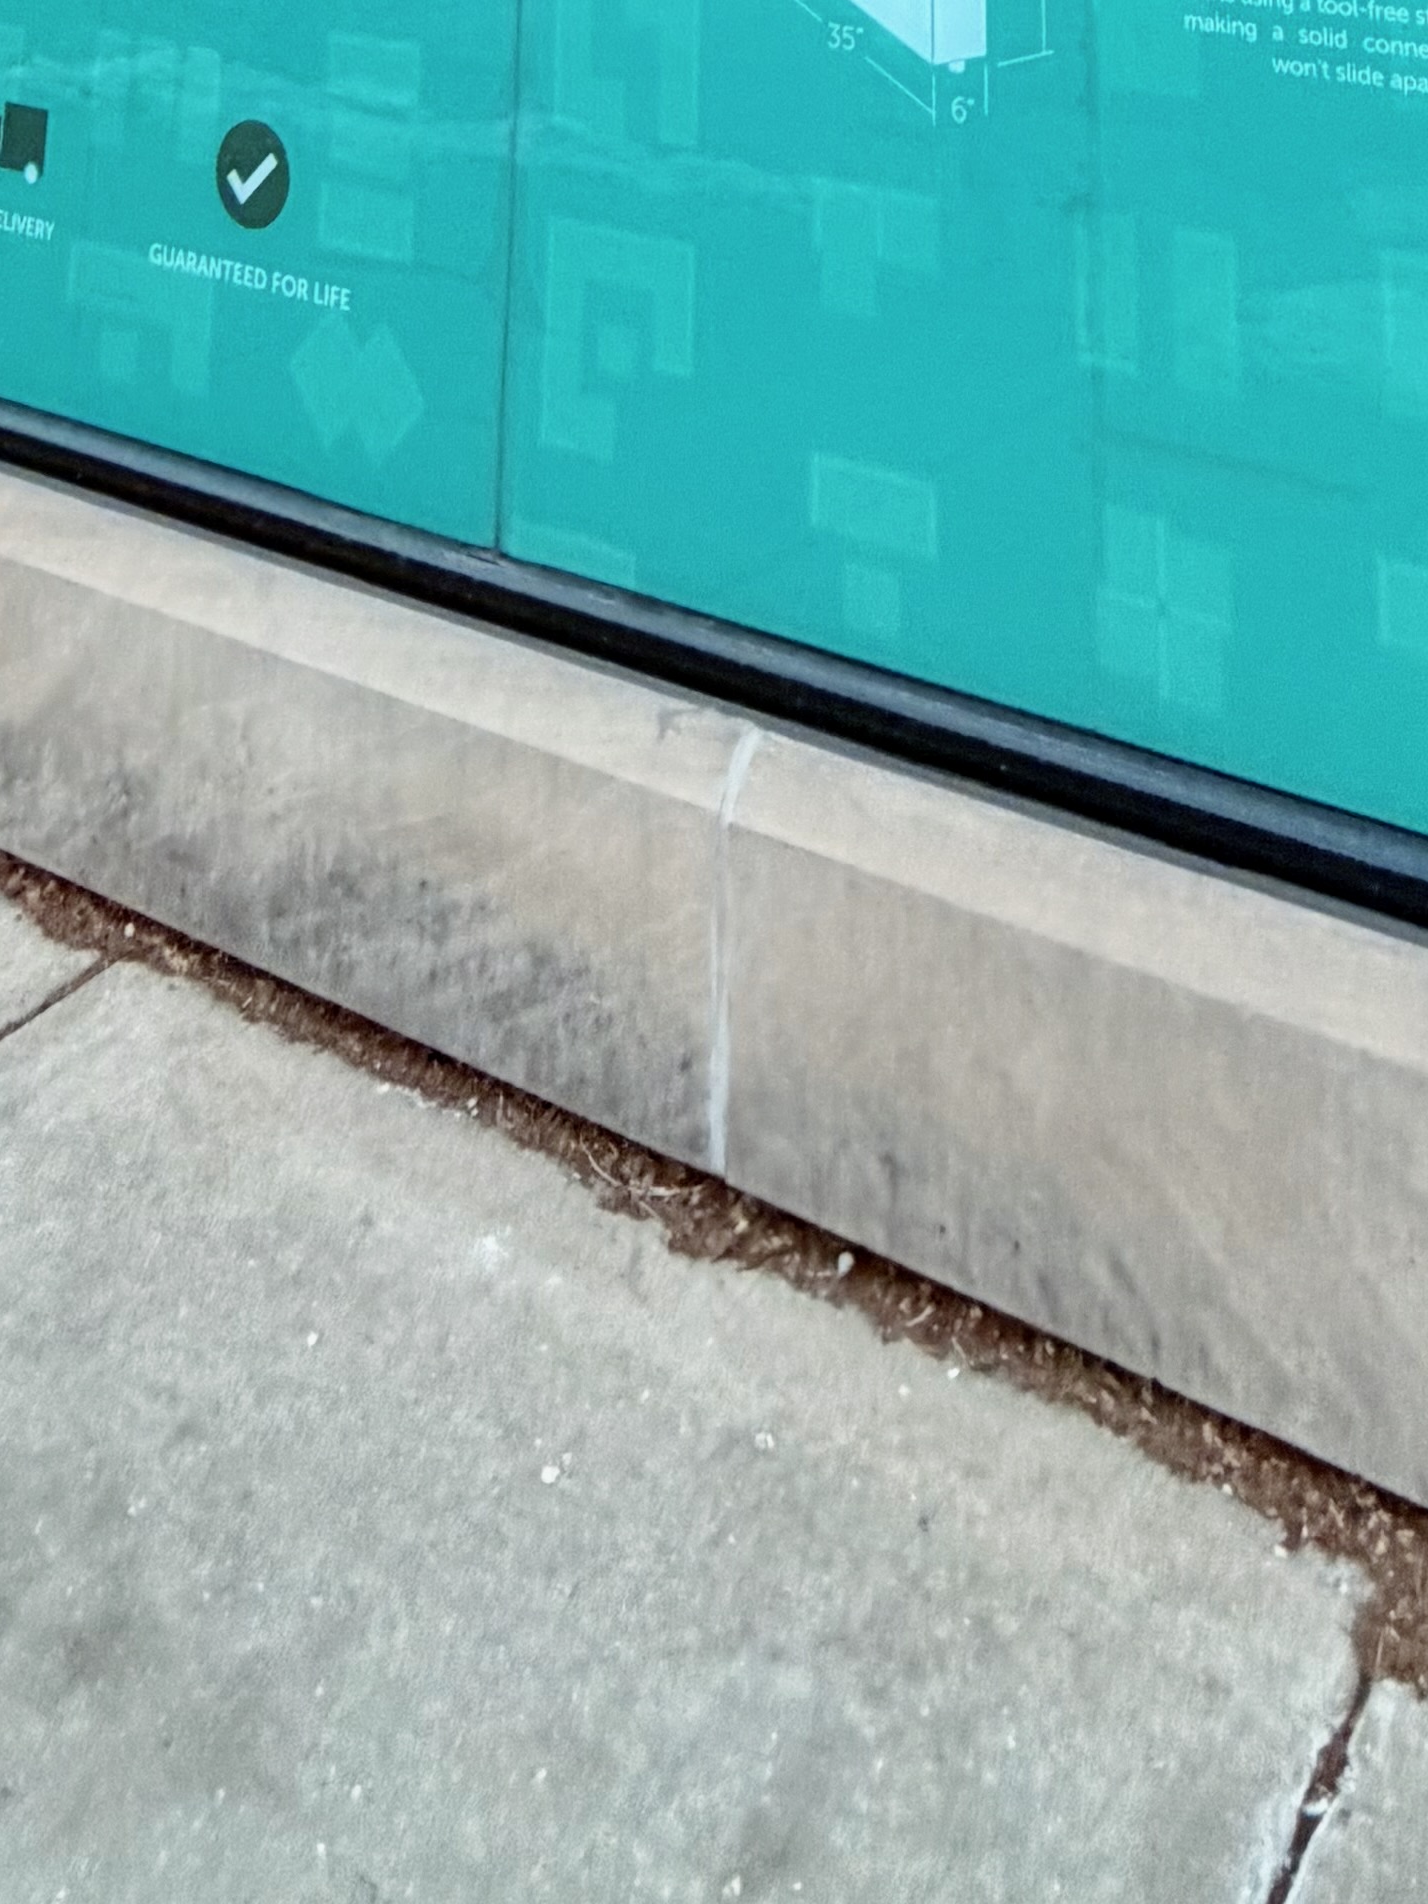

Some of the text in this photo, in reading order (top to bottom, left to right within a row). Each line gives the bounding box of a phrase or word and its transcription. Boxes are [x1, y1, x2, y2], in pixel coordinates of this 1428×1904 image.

[1183, 10, 1257, 42] making
[1272, 25, 1283, 41] a
[1298, 27, 1347, 50] solid
[1272, 57, 1330, 80] won't
[1336, 62, 1384, 87] slide
[148, 242, 351, 311] GUARANTEED FOR LIFE
